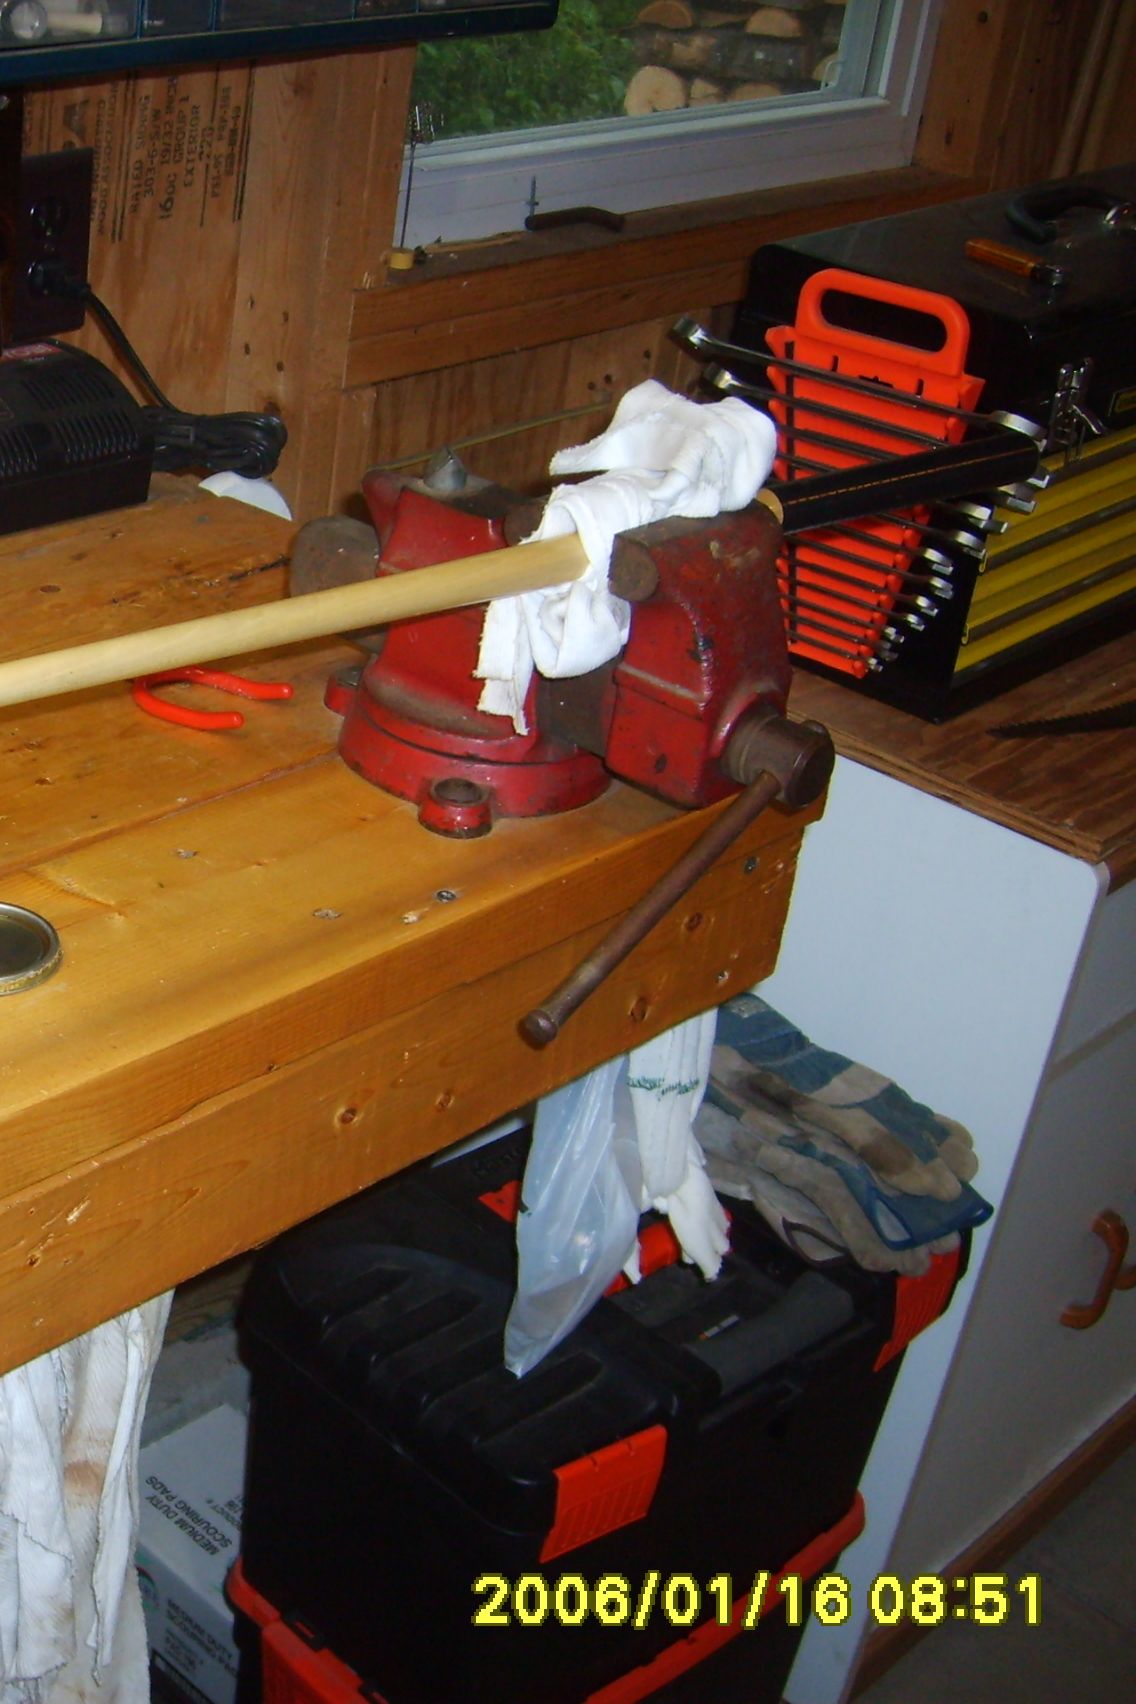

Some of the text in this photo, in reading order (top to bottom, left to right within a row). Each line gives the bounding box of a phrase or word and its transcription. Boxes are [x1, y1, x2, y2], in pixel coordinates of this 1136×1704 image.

[173, 110, 187, 164] GROUP
[183, 105, 201, 187] EXTERIOR
[144, 1474, 178, 1502] PADS
[145, 1492, 178, 1520] DUTY
[173, 1498, 233, 1549] SCOURING
[173, 1516, 220, 1556] MEDIUM
